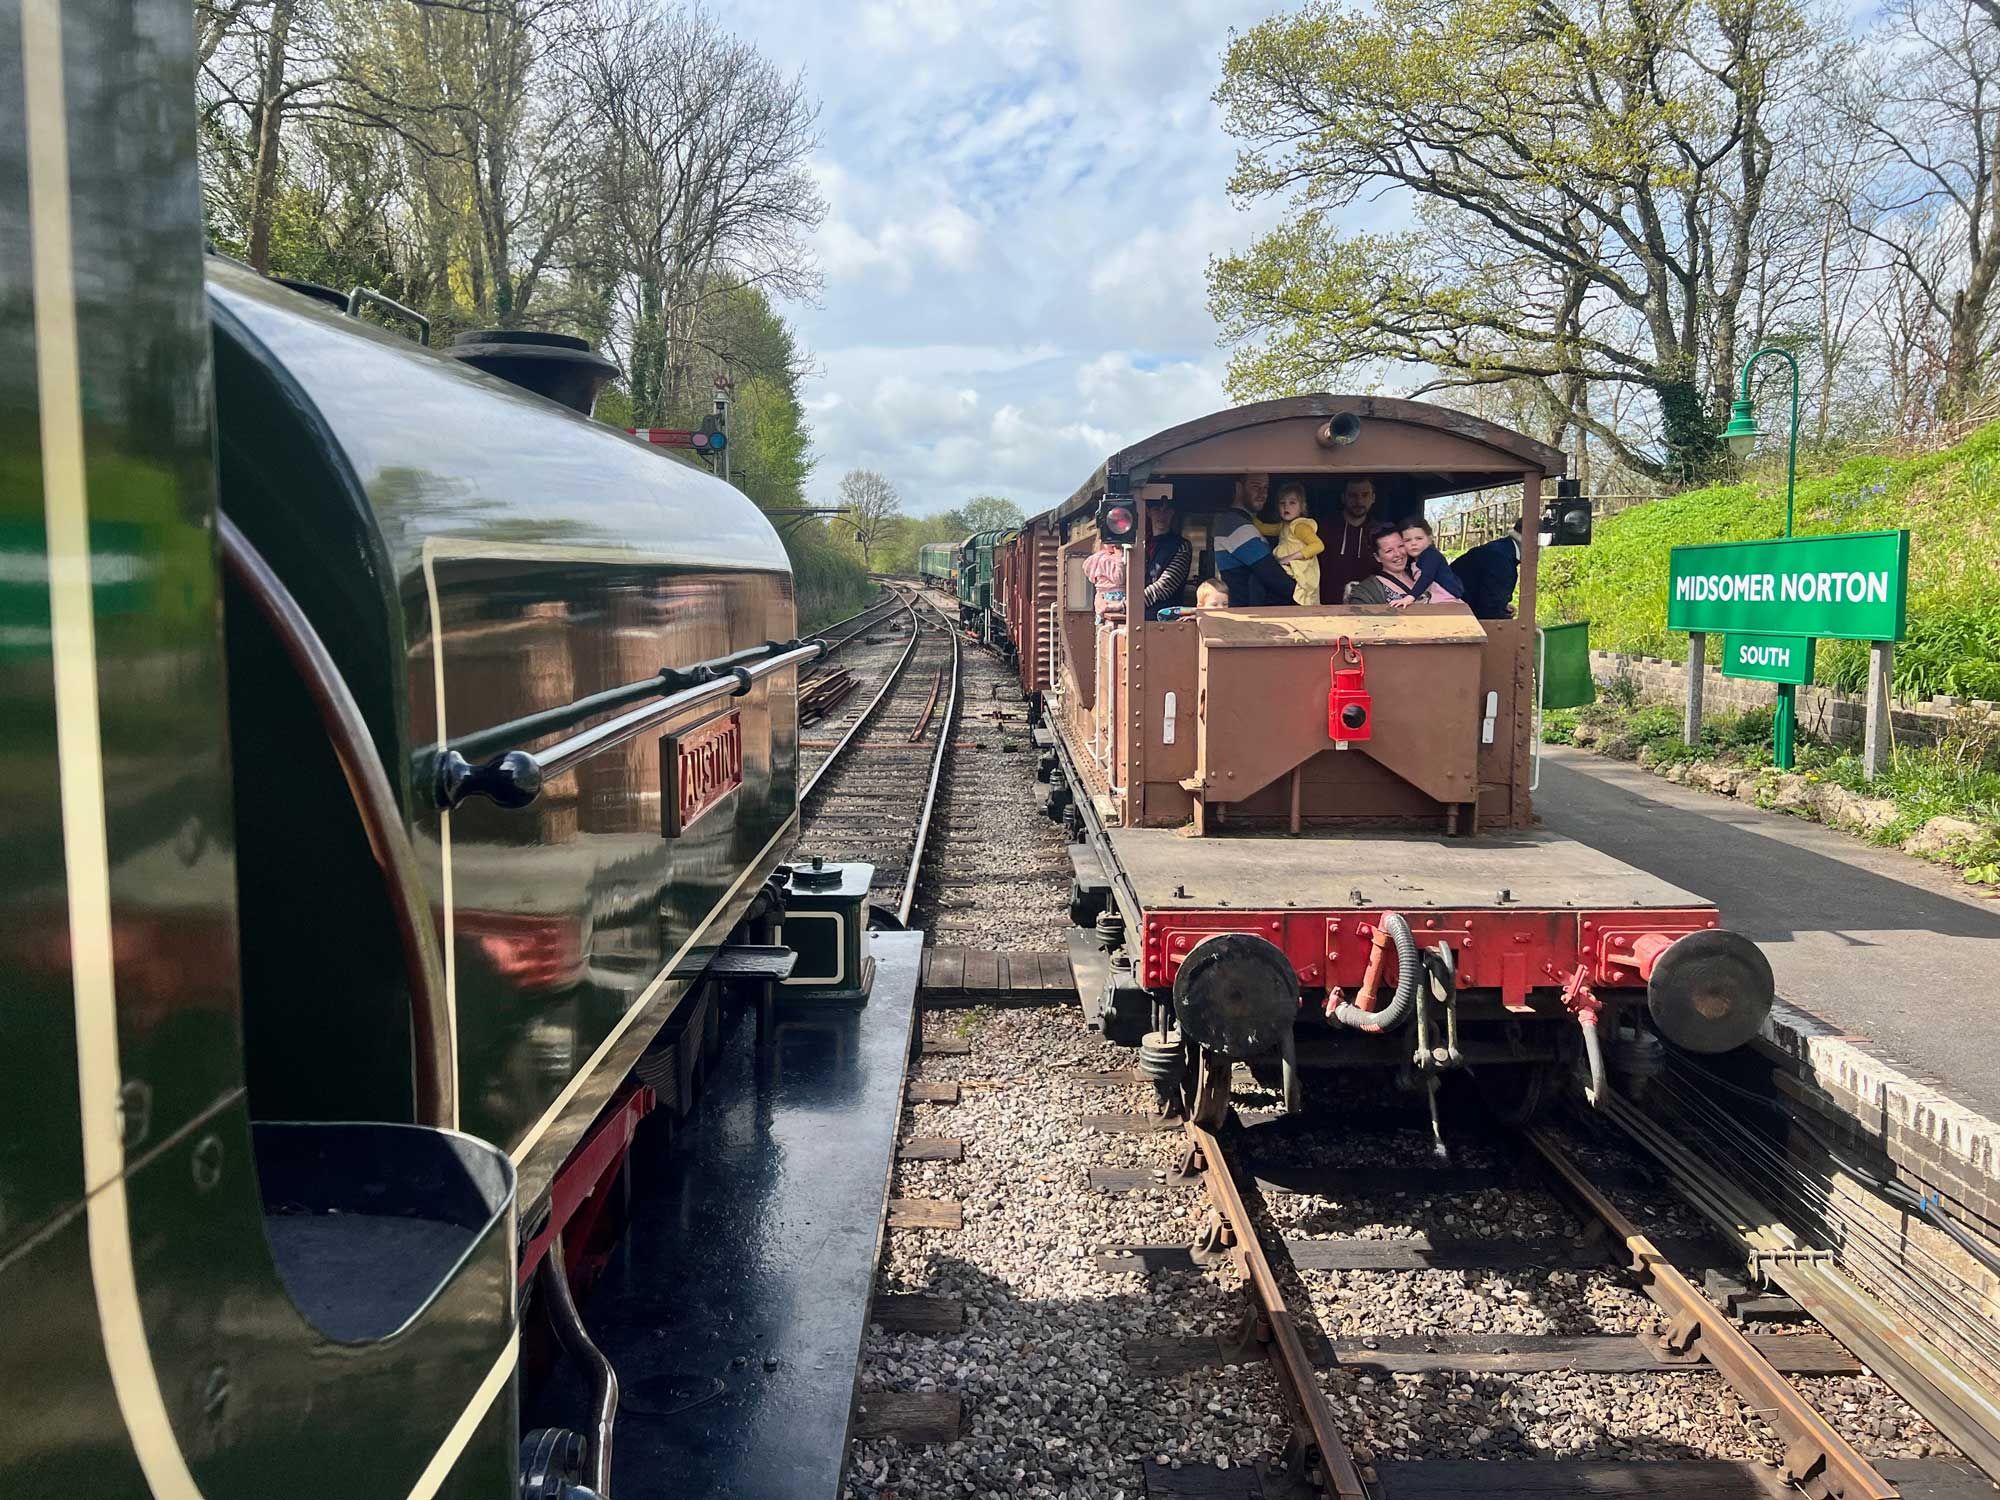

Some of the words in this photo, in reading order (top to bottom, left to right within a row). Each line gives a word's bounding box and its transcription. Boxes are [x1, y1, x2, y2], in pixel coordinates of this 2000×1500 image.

[1676, 574, 1775, 601] MIDSOMER
[1780, 571, 1888, 602] NORTON
[1739, 645, 1790, 667] SOUTH
